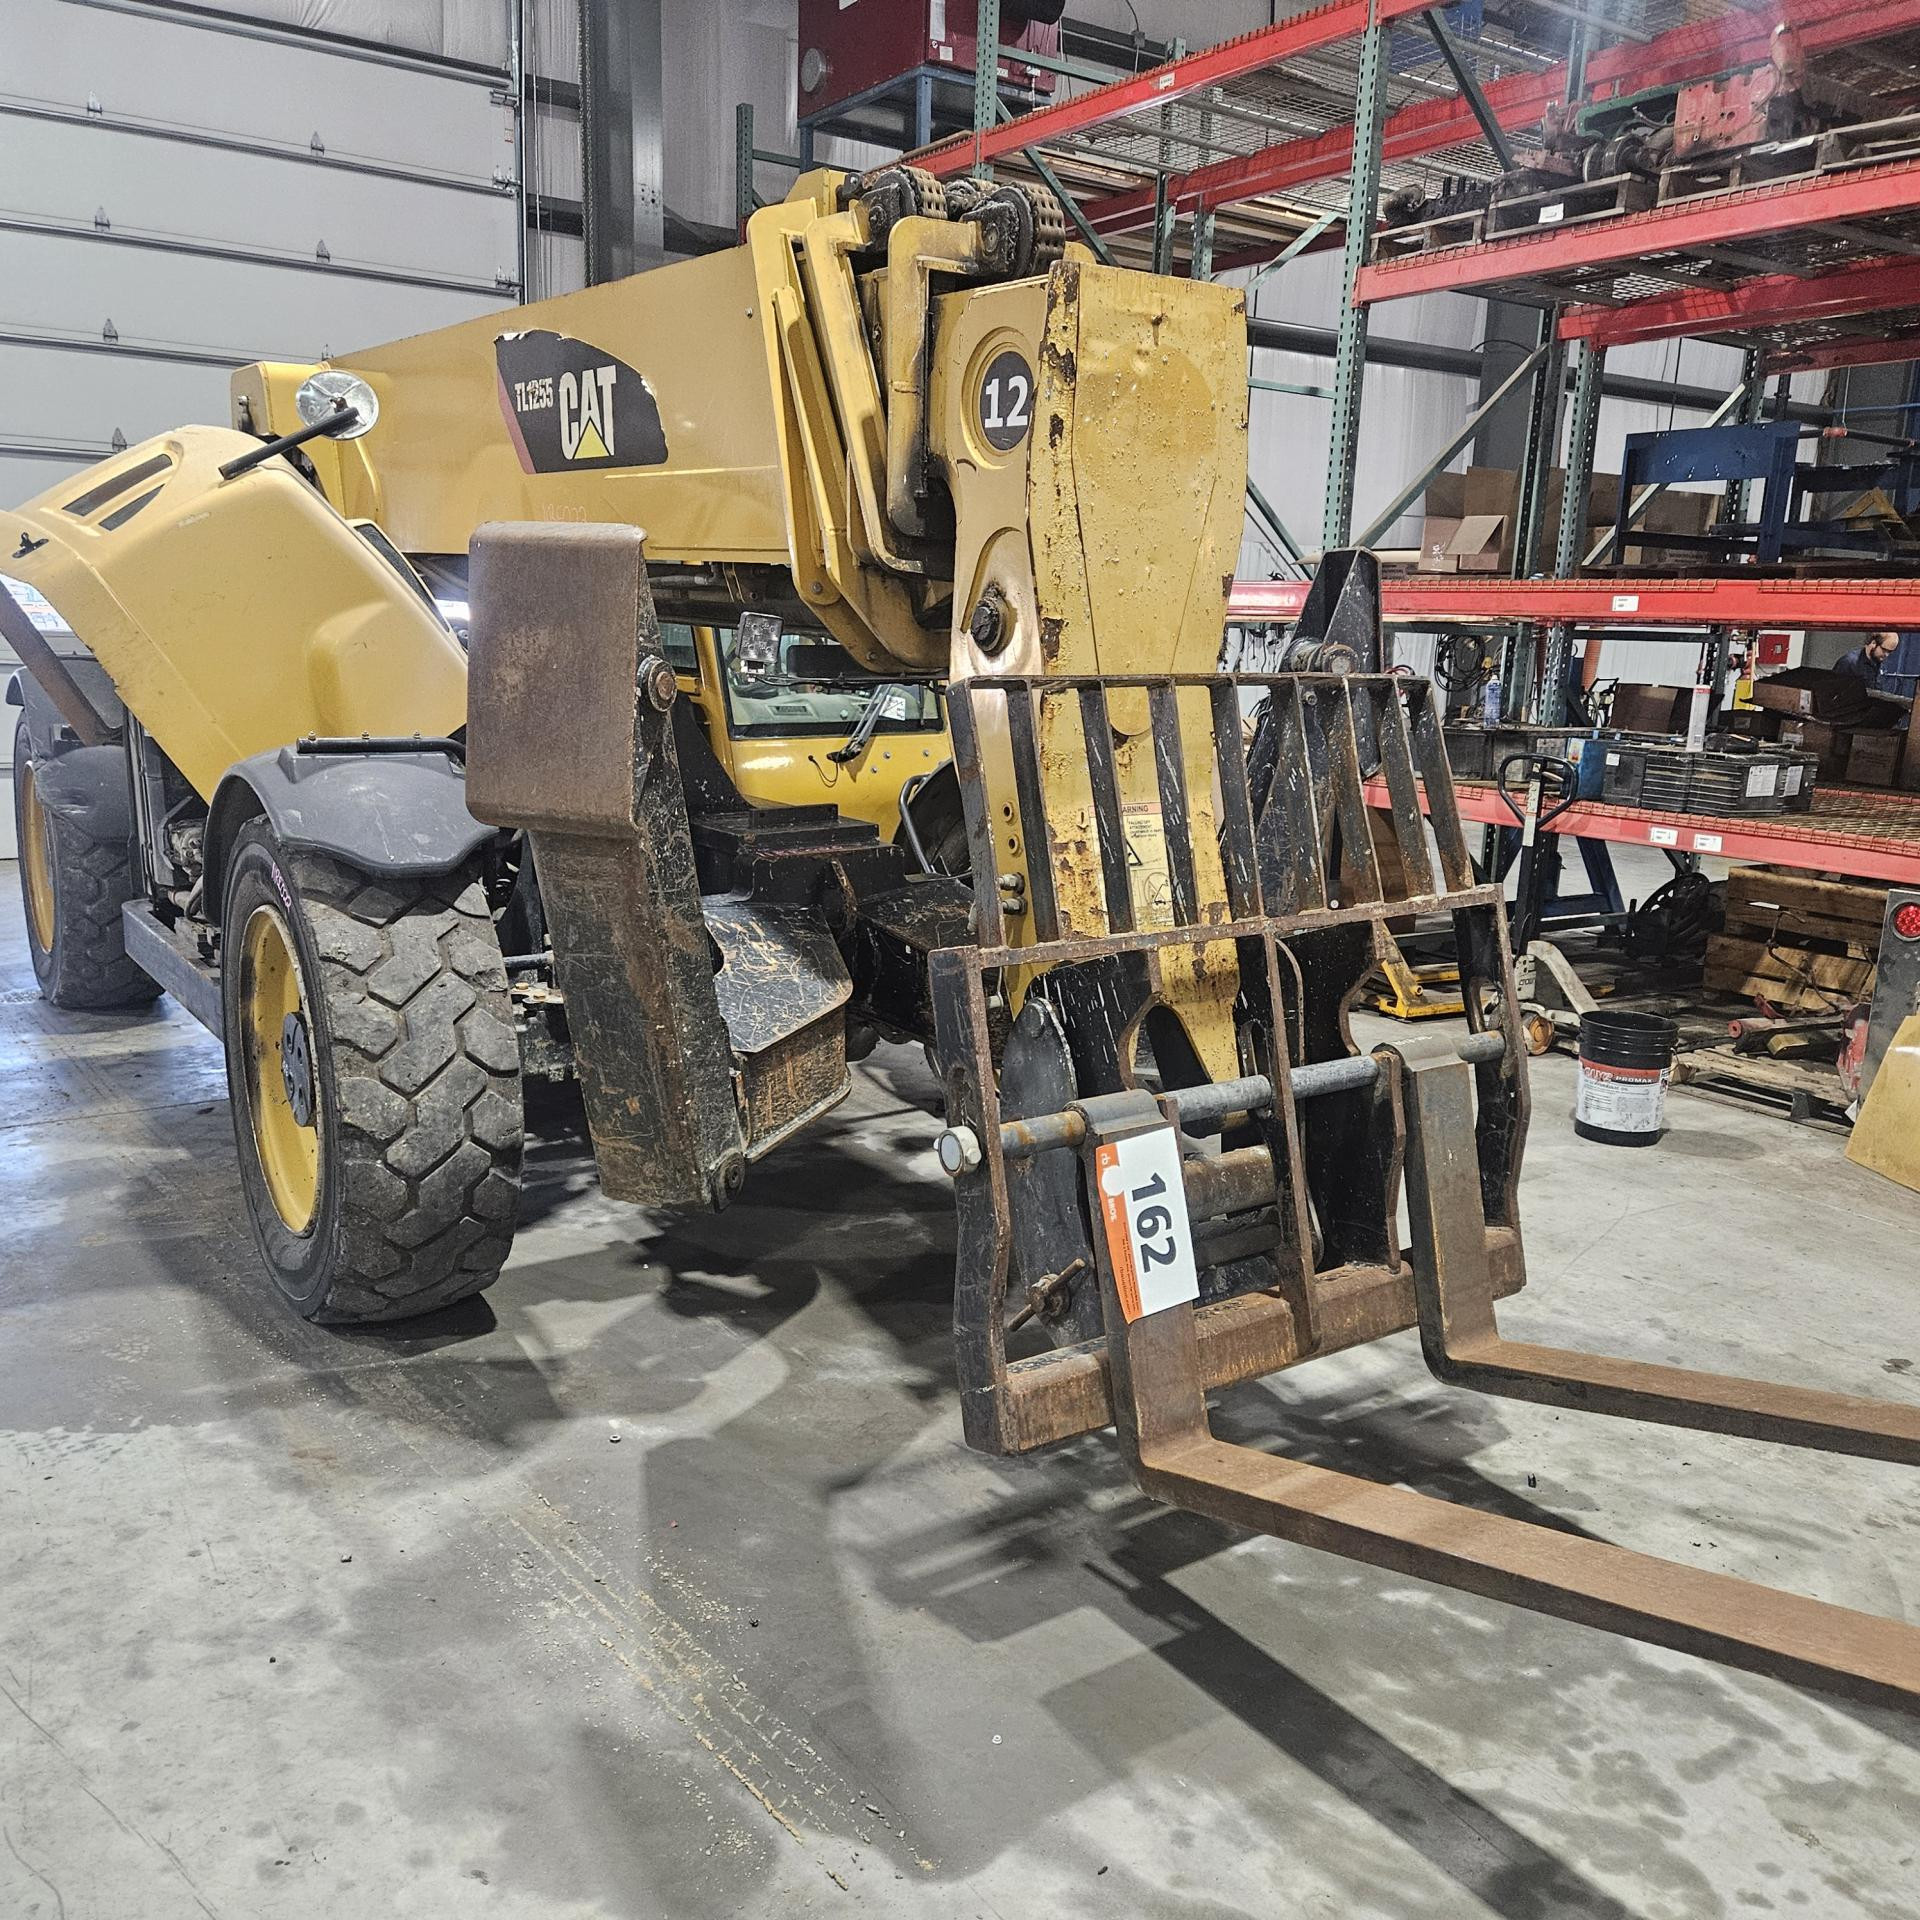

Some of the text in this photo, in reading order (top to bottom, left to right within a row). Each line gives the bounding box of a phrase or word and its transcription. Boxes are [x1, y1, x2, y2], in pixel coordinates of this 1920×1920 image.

[514, 364, 617, 460] TL1255 CAT
[984, 375, 1029, 428] 12
[1121, 804, 1149, 813] ARNING
[1615, 1075, 1653, 1084] PROMAX
[1131, 1171, 1177, 1274] 162
